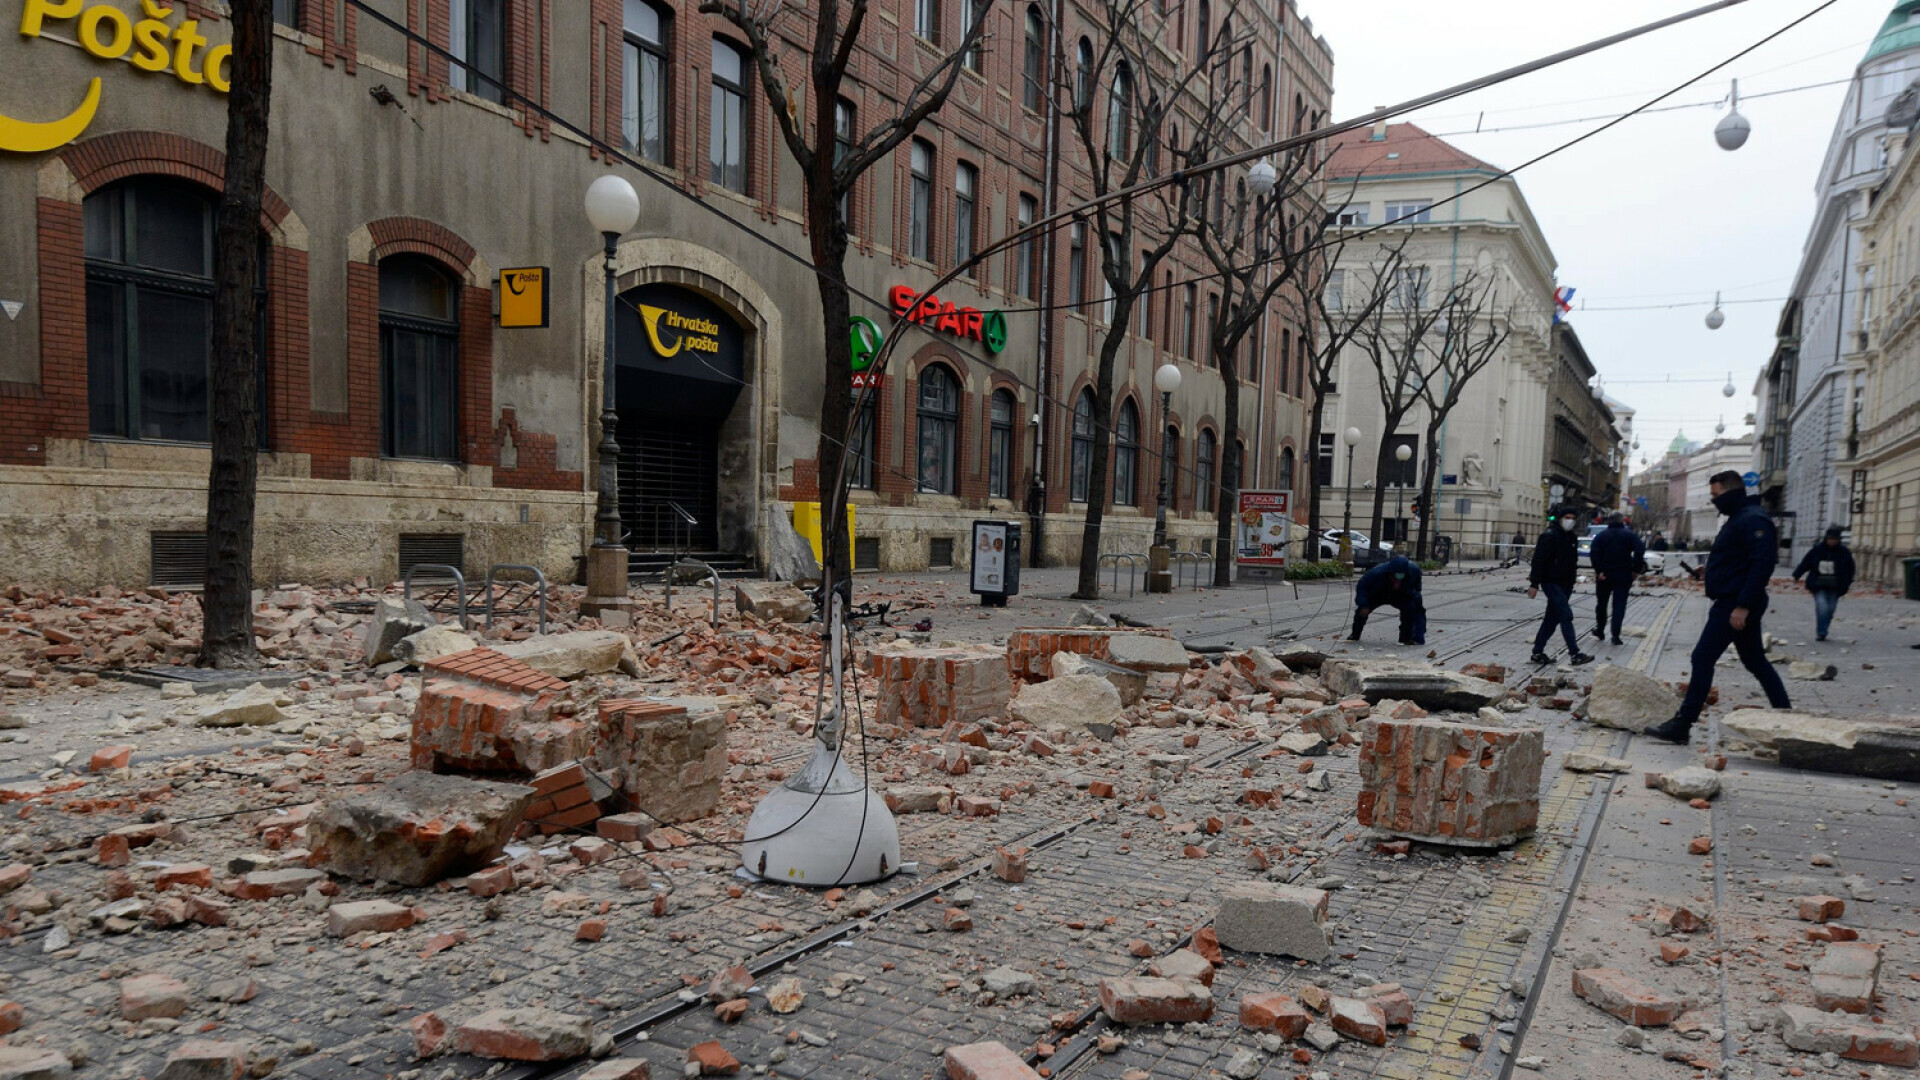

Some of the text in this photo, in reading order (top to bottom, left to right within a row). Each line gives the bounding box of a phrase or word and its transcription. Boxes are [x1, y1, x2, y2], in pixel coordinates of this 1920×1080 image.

[520, 272, 539, 282] Pošta
[889, 284, 983, 342] SPAR
[667, 310, 719, 335] Hrvatska
[685, 336, 719, 352] pošta
[851, 375, 876, 385] AR
